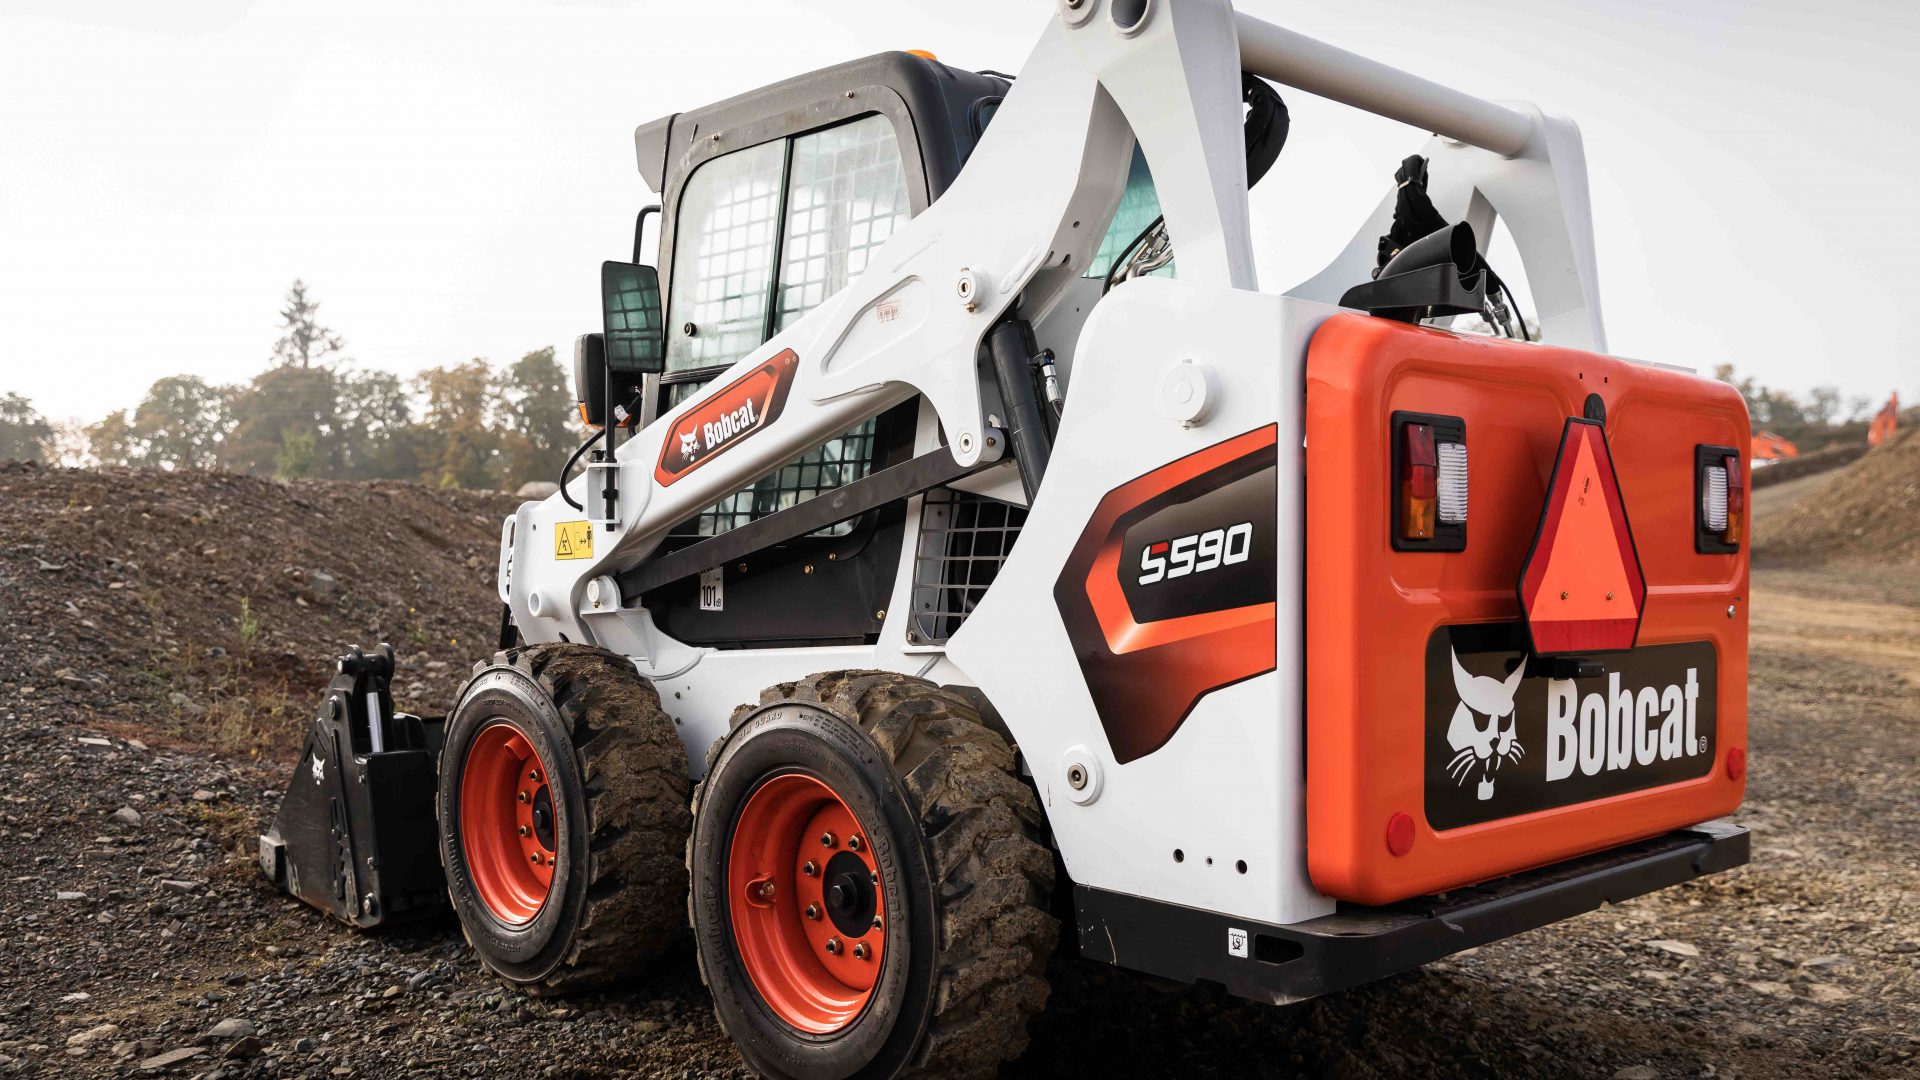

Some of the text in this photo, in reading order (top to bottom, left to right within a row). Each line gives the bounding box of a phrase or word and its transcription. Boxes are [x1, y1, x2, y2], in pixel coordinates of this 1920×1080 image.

[703, 398, 756, 450] Bobcat
[1138, 522, 1253, 586] S590
[702, 585, 716, 607] 101
[1546, 667, 1699, 782] Bobcat
[878, 835, 905, 925] Bobcat
